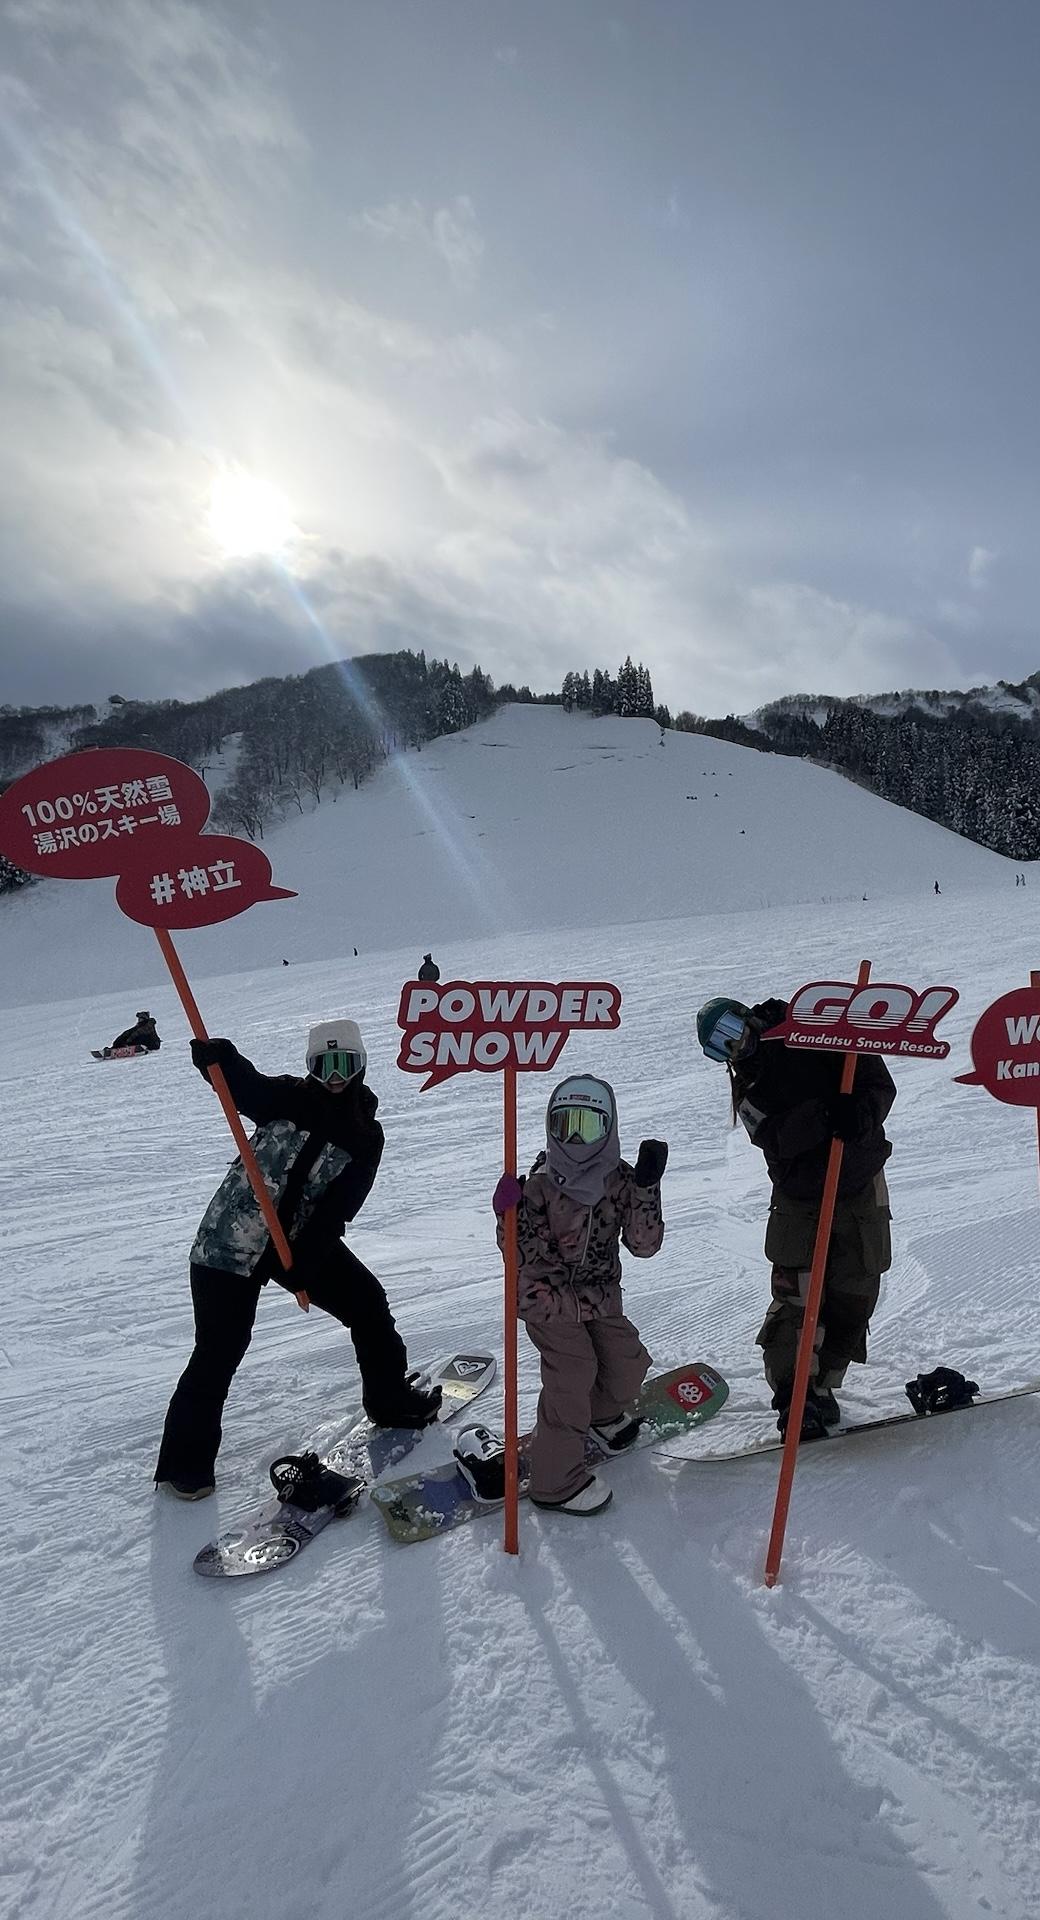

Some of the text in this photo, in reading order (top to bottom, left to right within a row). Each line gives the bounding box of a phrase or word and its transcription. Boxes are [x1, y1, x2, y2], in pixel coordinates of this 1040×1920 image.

[21, 774, 174, 827] 100%天然雪
[32, 803, 182, 855] 湯沢のスキー場
[406, 989, 613, 1022] POWDER
[792, 986, 952, 1032] GO!
[788, 1032, 946, 1055] Kandatsu Snow Resort
[1005, 1014, 1040, 1046] W
[406, 1031, 561, 1065] SNOW
